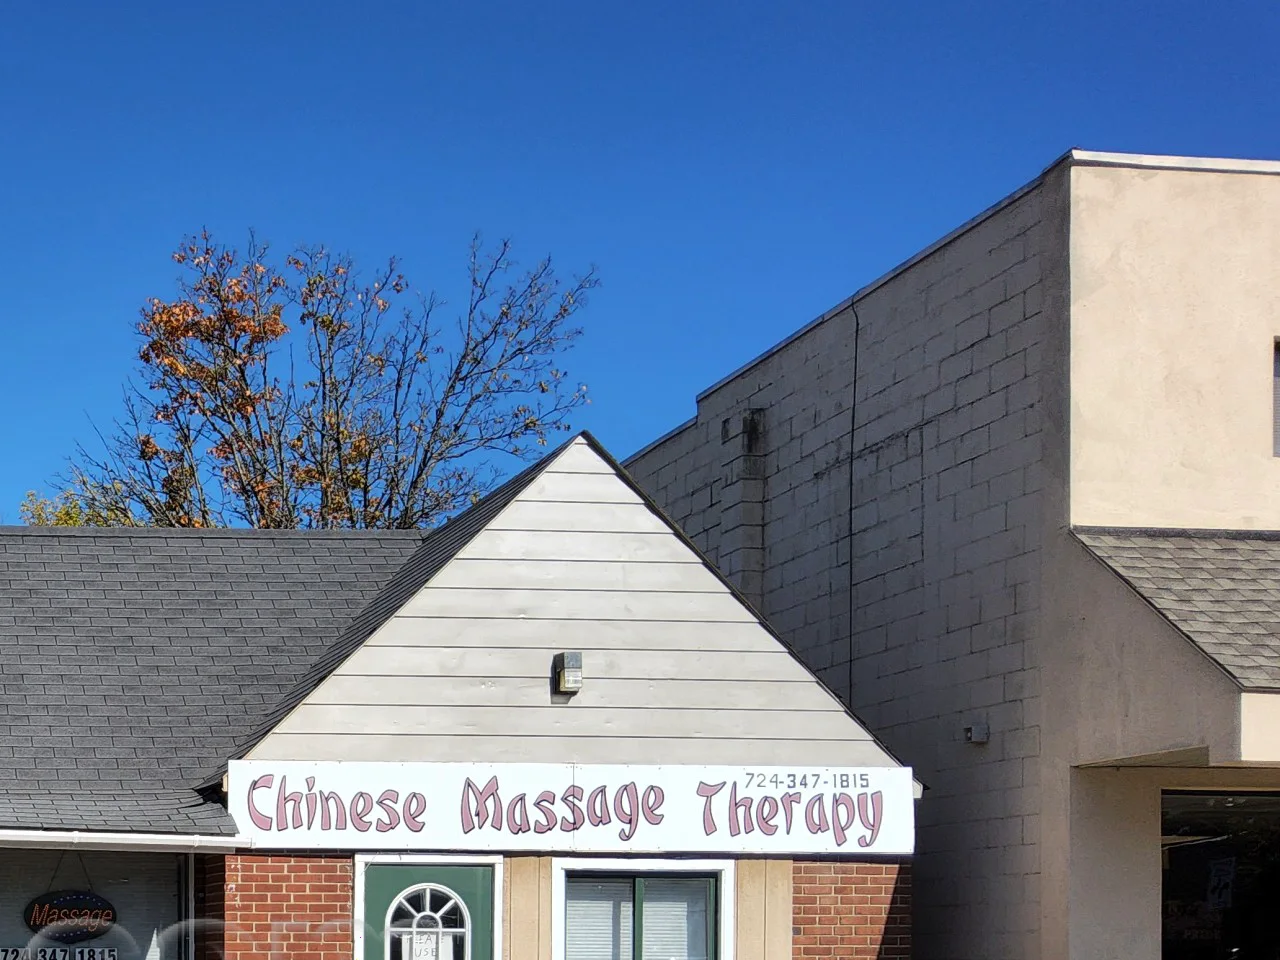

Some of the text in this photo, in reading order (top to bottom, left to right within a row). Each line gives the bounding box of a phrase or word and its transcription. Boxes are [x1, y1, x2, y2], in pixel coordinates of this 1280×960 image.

[744, 772, 870, 789] 724-347-1815
[247, 774, 883, 847] Chinese Massage Therapy
[30, 903, 113, 932] Massage
[414, 948, 437, 957] USE
